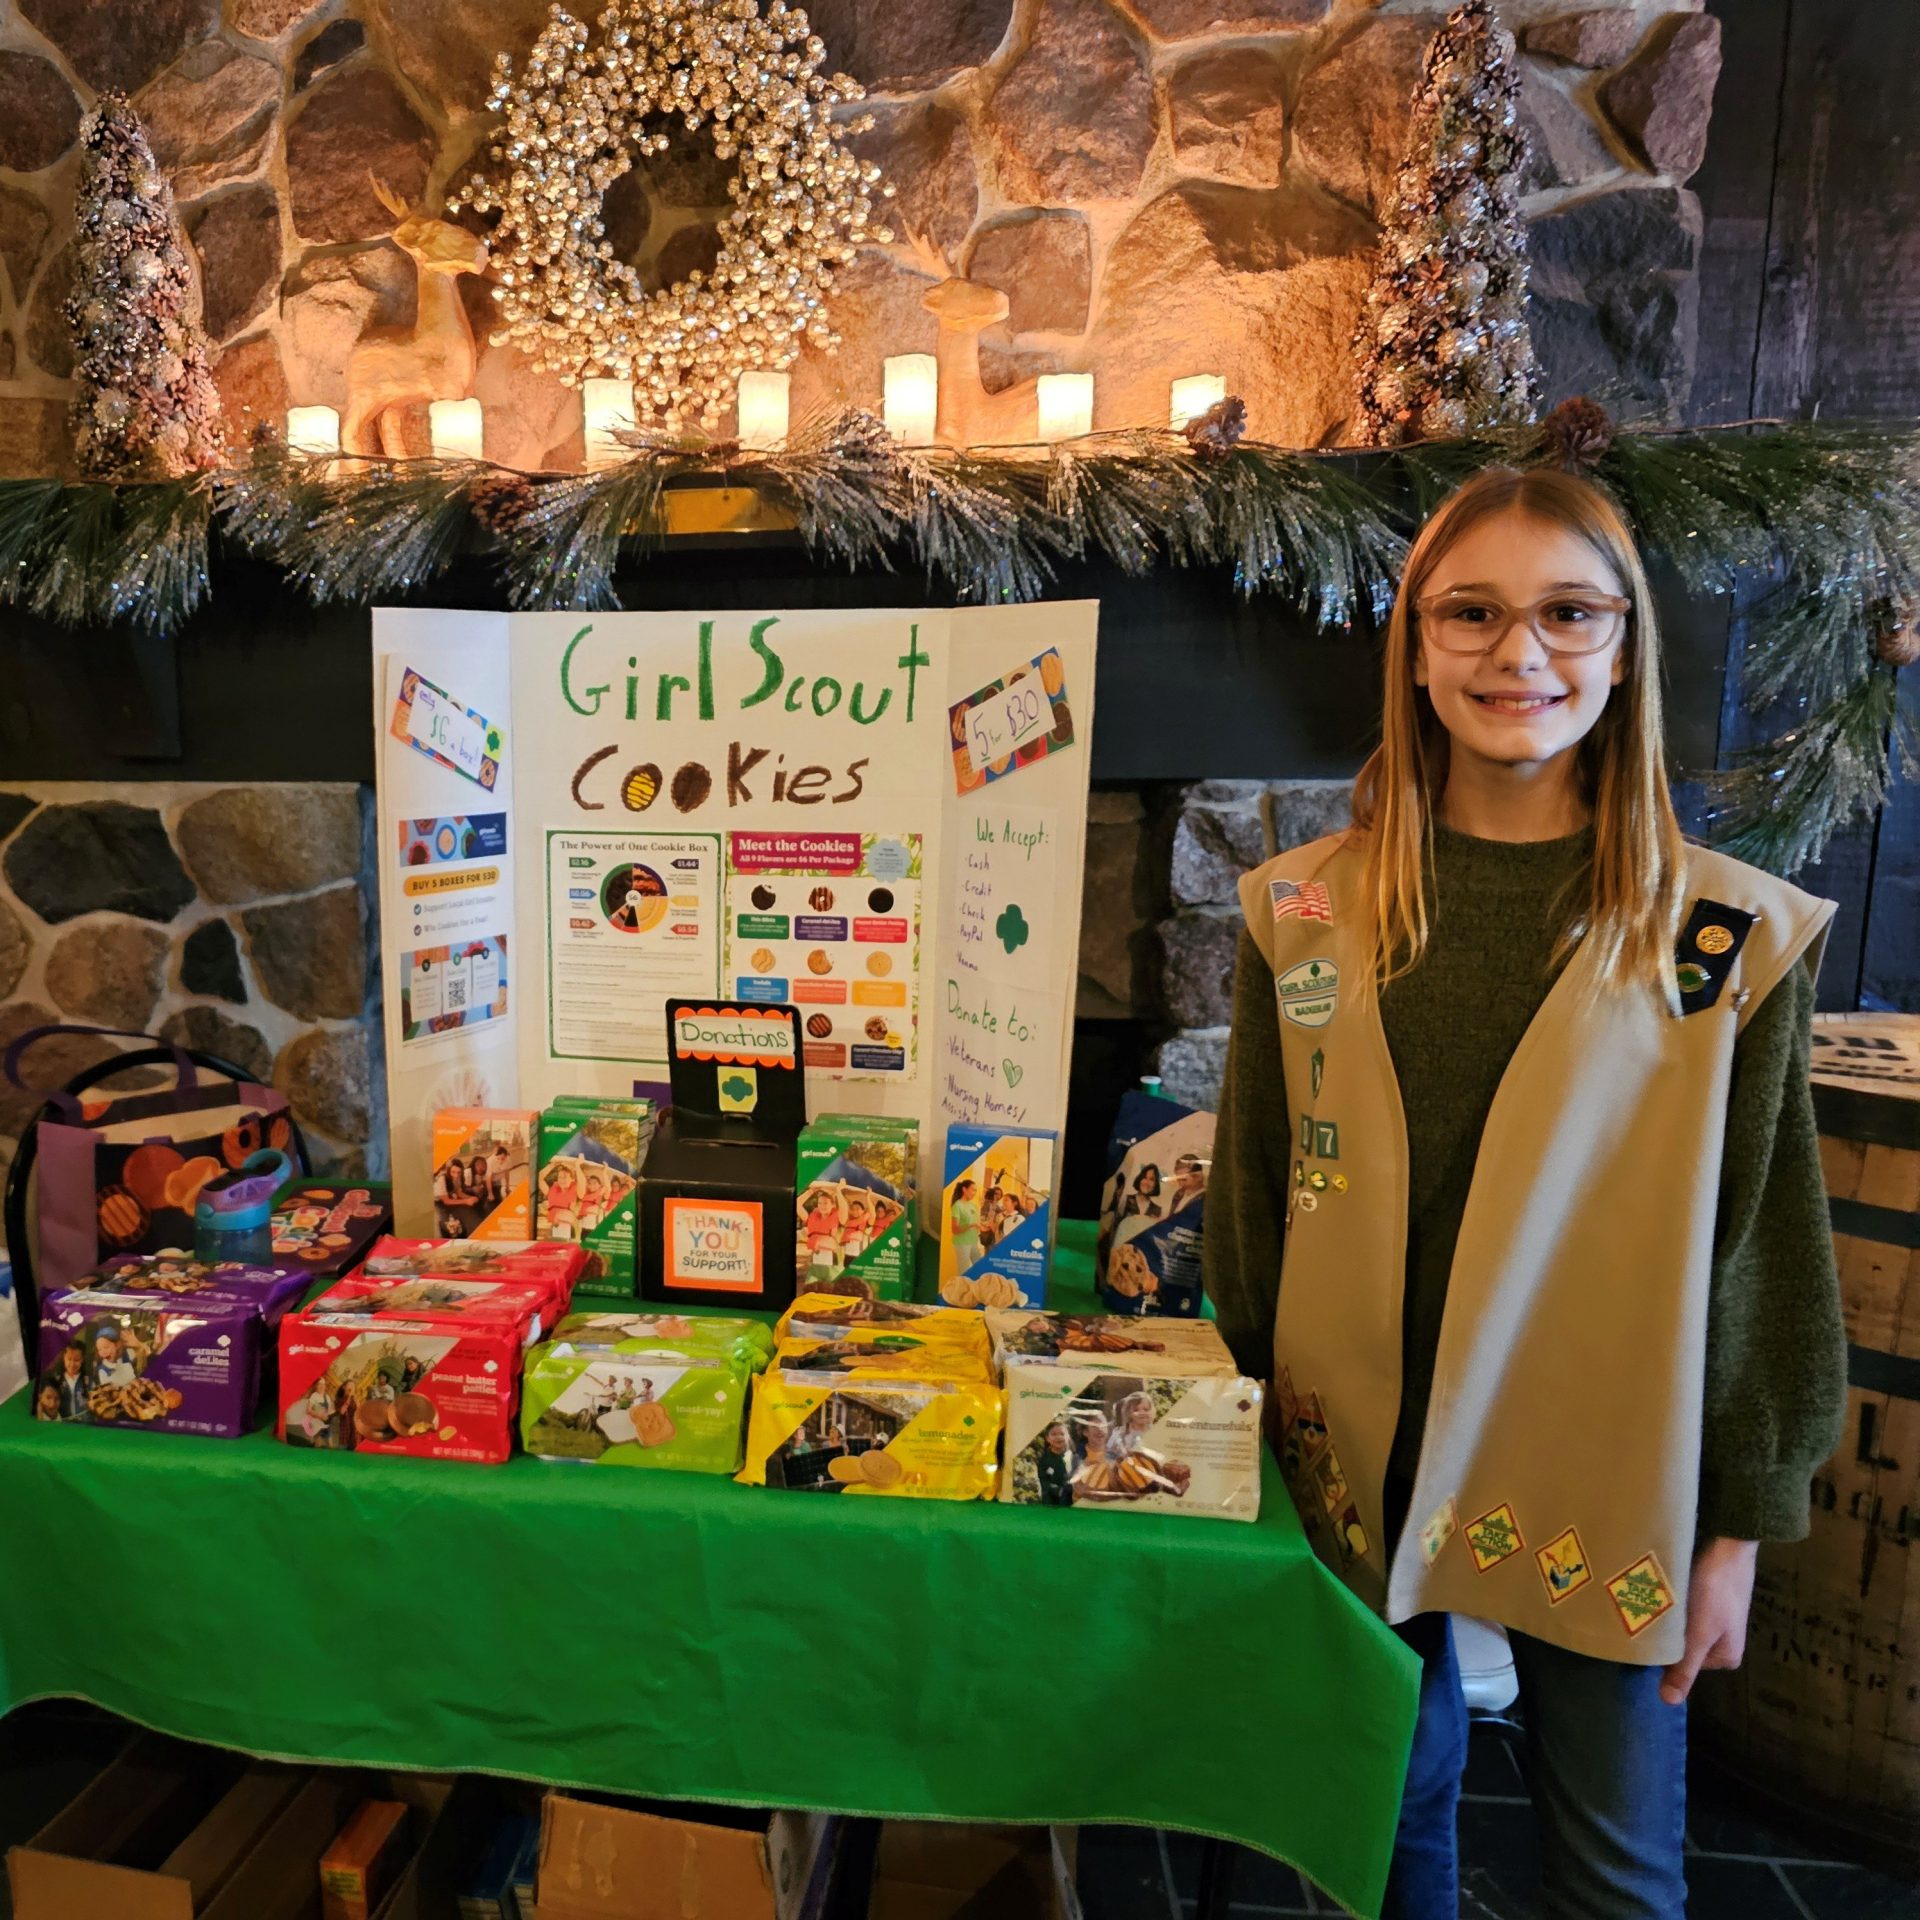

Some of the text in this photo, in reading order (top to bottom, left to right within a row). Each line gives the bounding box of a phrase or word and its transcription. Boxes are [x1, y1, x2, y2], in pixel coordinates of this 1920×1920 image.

[560, 616, 930, 725] Girl Scout
[973, 712, 990, 757] 5
[1006, 689, 1040, 738] $30
[560, 840, 708, 852] The Power of One Cookie Box
[739, 839, 854, 852] Meet the Cookies
[977, 817, 1049, 861] We Accept:
[739, 854, 750, 862] All
[757, 855, 784, 863] Flavors
[823, 856, 854, 865] Package
[968, 852, 990, 870] Cash
[413, 871, 496, 890] BUY 5 BOXES FOR $30
[965, 880, 992, 896] Credit
[960, 924, 983, 943] PayPal
[948, 979, 1037, 1042] Donate to:
[681, 1021, 789, 1048] Donations
[949, 1035, 996, 1078] Veterans
[948, 1073, 980, 1115] Nursing
[684, 1215, 742, 1233] THANK
[690, 1231, 742, 1250] YOU
[682, 1255, 748, 1271] SUPPORT!
[690, 1249, 738, 1259] FOR YOUR
[188, 1347, 230, 1357] caramel
[1472, 1533, 1513, 1551] ACTION
[1483, 1526, 1509, 1543] TAKE
[1628, 1582, 1657, 1598] TAKE
